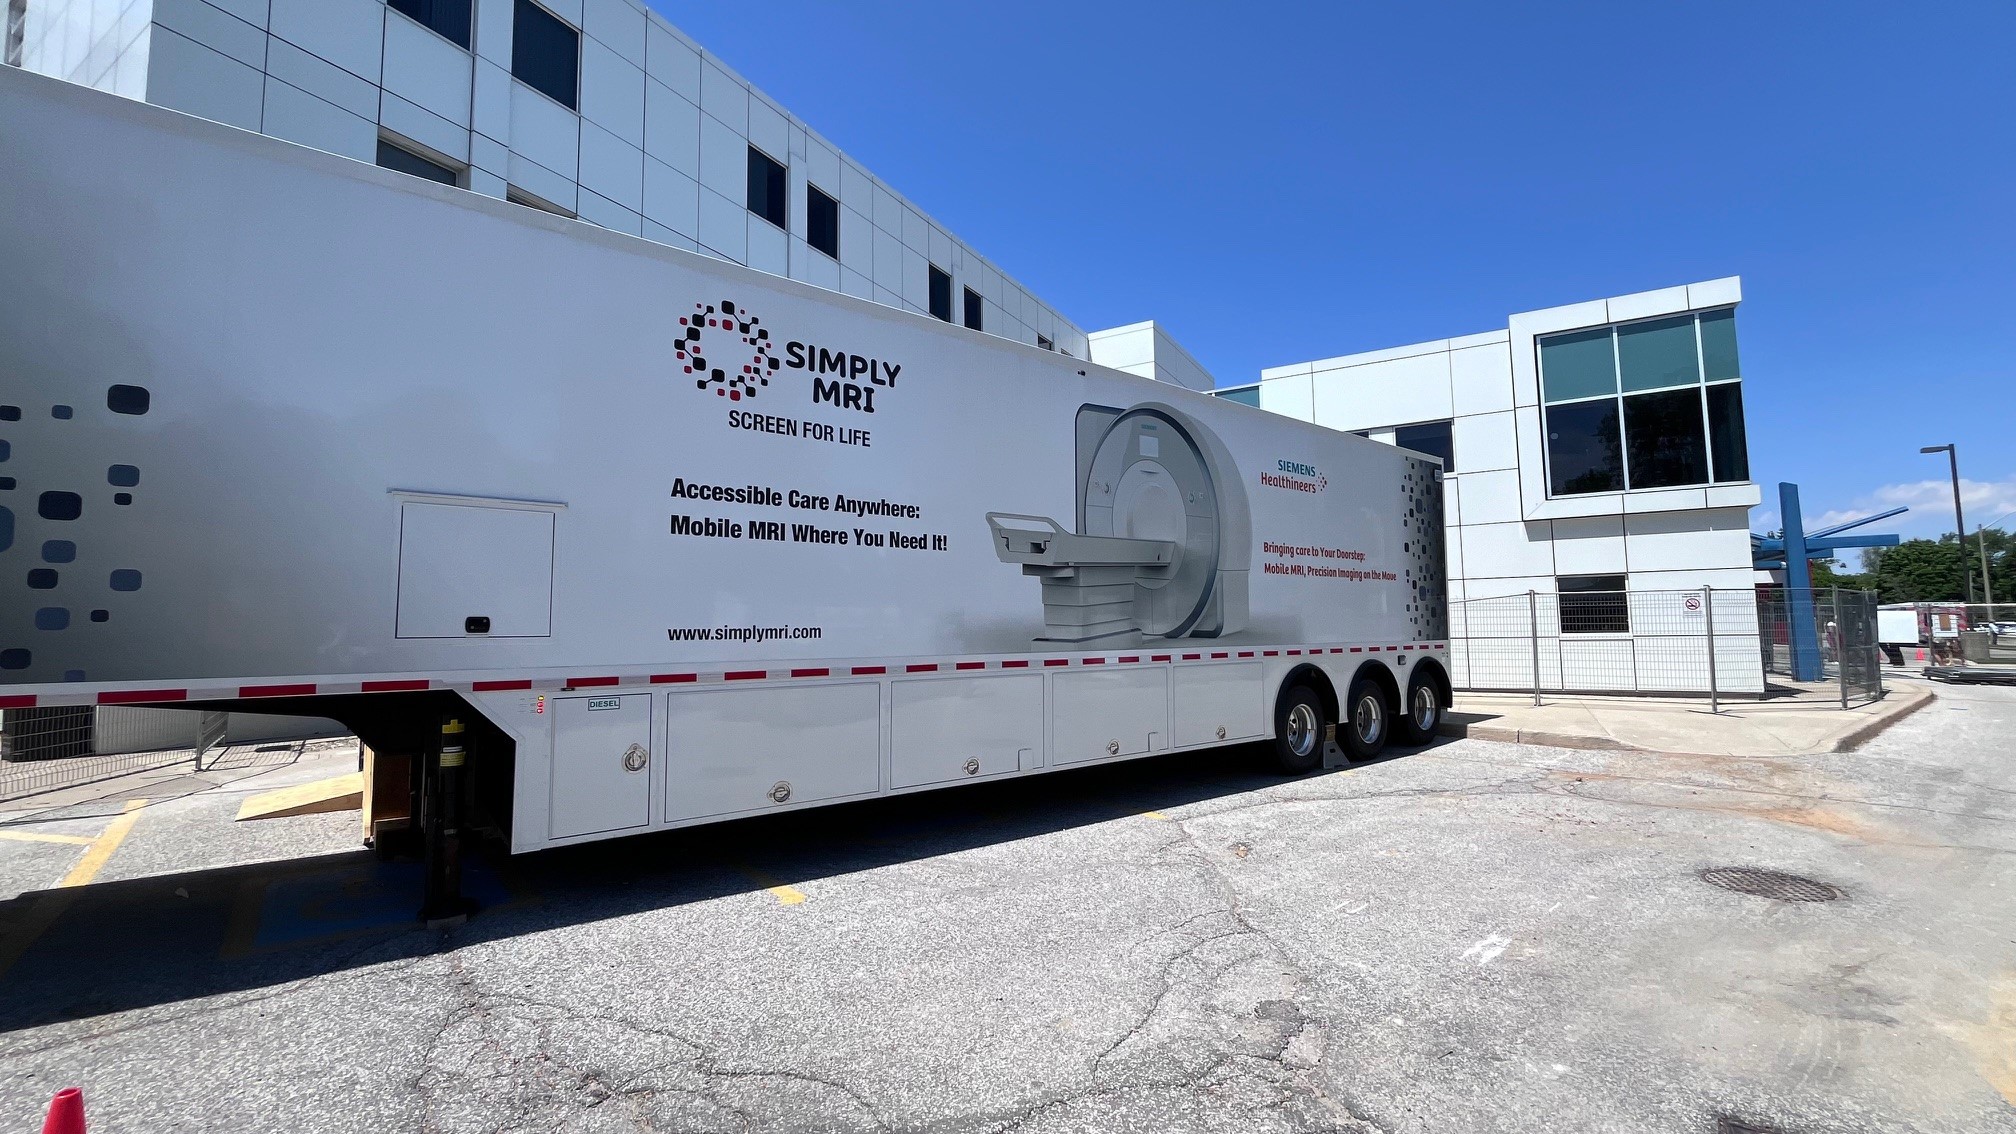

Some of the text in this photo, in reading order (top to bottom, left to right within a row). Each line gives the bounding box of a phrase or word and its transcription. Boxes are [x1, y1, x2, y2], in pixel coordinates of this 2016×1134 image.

[785, 341, 901, 388] SIMPLY
[813, 377, 875, 413] MRI
[728, 409, 871, 448] SCREEN FOR LIFE
[1277, 459, 1316, 477] SIEMENS
[1261, 472, 1317, 494] Healthineers
[670, 477, 920, 519] Accessible Care Anywhere:
[670, 515, 948, 551] Mobile MRI Where You Need It!
[1263, 541, 1366, 563] Bringing care to Your Doorstep:
[1264, 562, 1289, 576] Mobile
[1290, 564, 1306, 578] MRI,
[1307, 566, 1337, 578] Precision
[1338, 568, 1363, 582] Imaging
[1363, 571, 1371, 580] on
[1371, 570, 1381, 580] the
[667, 624, 822, 643] www.simplymri.com
[589, 700, 619, 708] DIESEL
